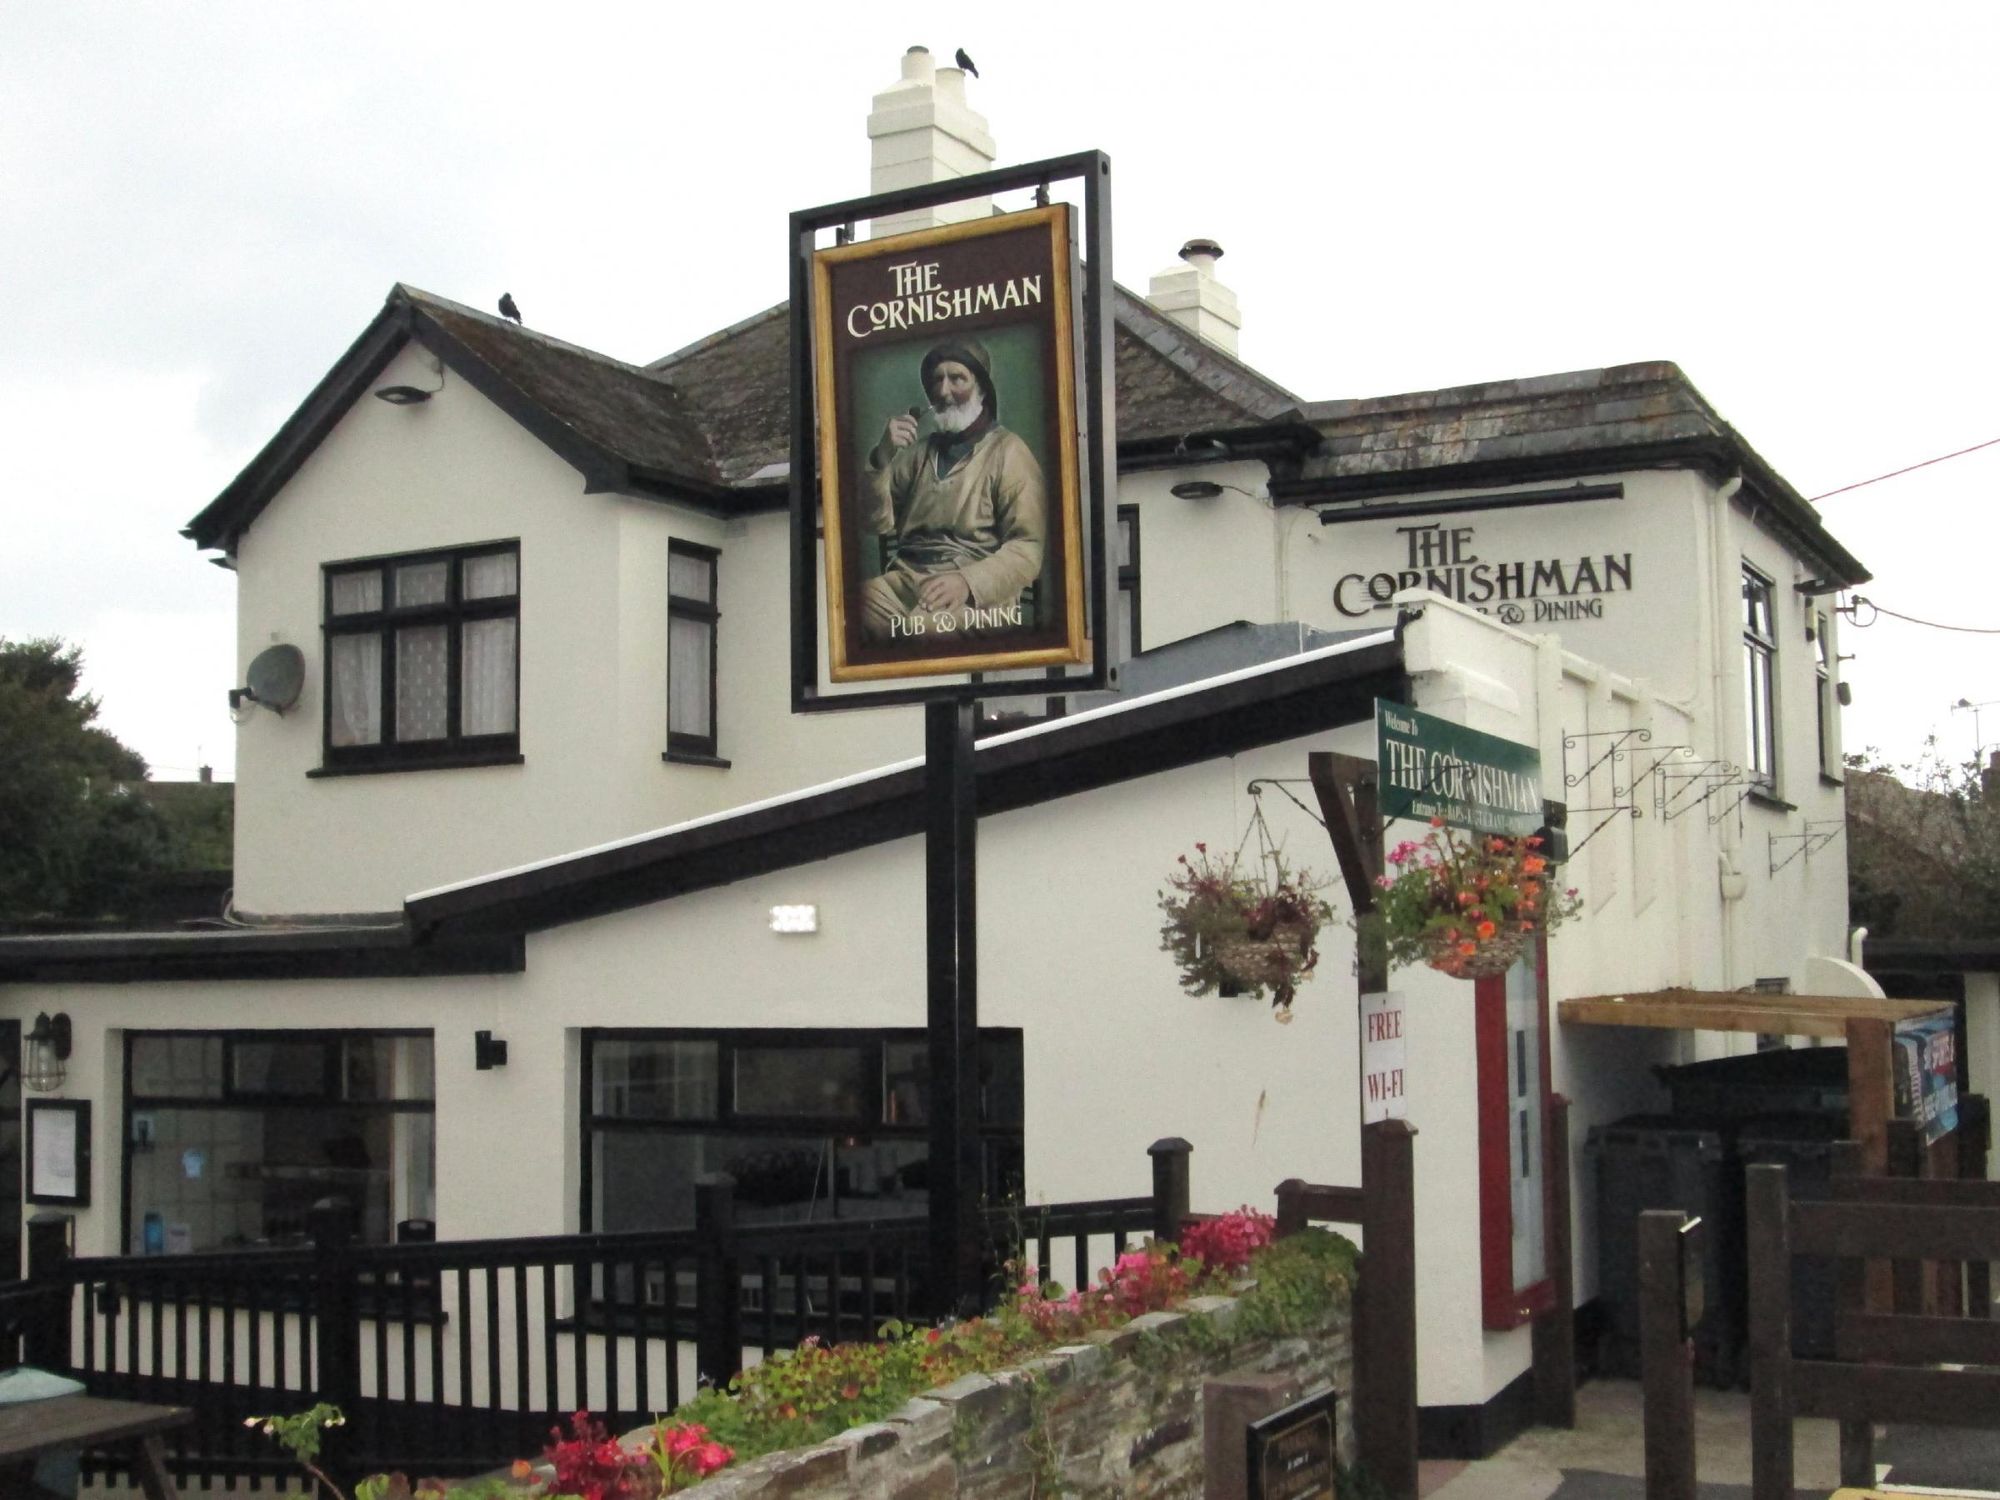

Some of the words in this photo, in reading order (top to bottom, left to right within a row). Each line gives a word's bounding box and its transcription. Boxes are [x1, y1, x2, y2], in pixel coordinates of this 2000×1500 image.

[888, 261, 942, 297] THE
[847, 274, 1042, 338] CORNISHMAN
[1396, 522, 1478, 569] THE
[890, 614, 926, 638] PUB
[932, 611, 957, 634] &
[964, 604, 1022, 630] DINING
[1497, 603, 1525, 624] &
[1533, 598, 1603, 622] DINING
[1386, 738, 1426, 791] THE
[1430, 750, 1539, 813] CORNISHMAN
[1367, 1009, 1403, 1043] FREE
[1367, 1068, 1404, 1102] WI-FI
